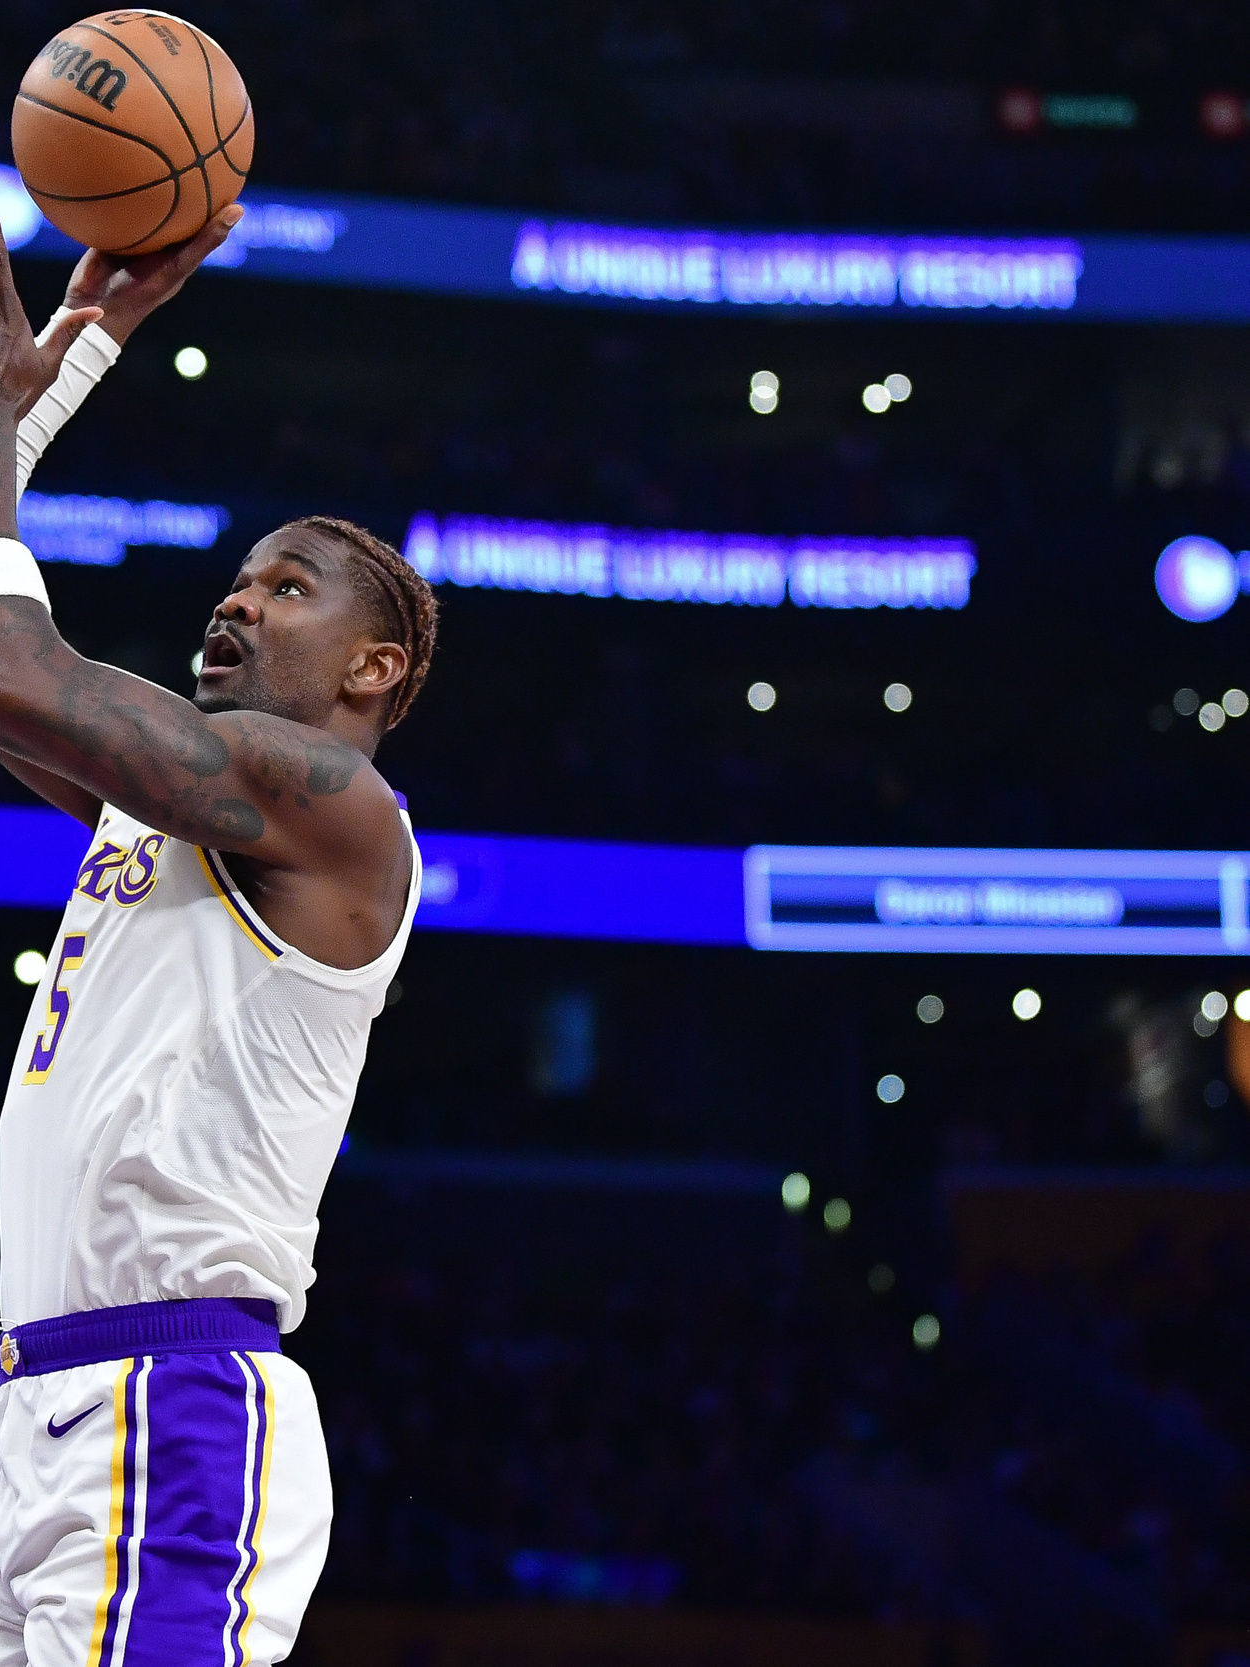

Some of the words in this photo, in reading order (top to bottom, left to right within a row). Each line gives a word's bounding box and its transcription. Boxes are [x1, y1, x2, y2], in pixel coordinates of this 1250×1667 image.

[551, 221, 722, 302] UNIQUE
[722, 231, 898, 305] LUXURY
[898, 236, 1082, 308] RESORT
[442, 514, 614, 598] UNIQUE
[614, 526, 787, 607] LUXURY
[788, 537, 976, 609] RESORT
[21, 931, 88, 1086] 5
